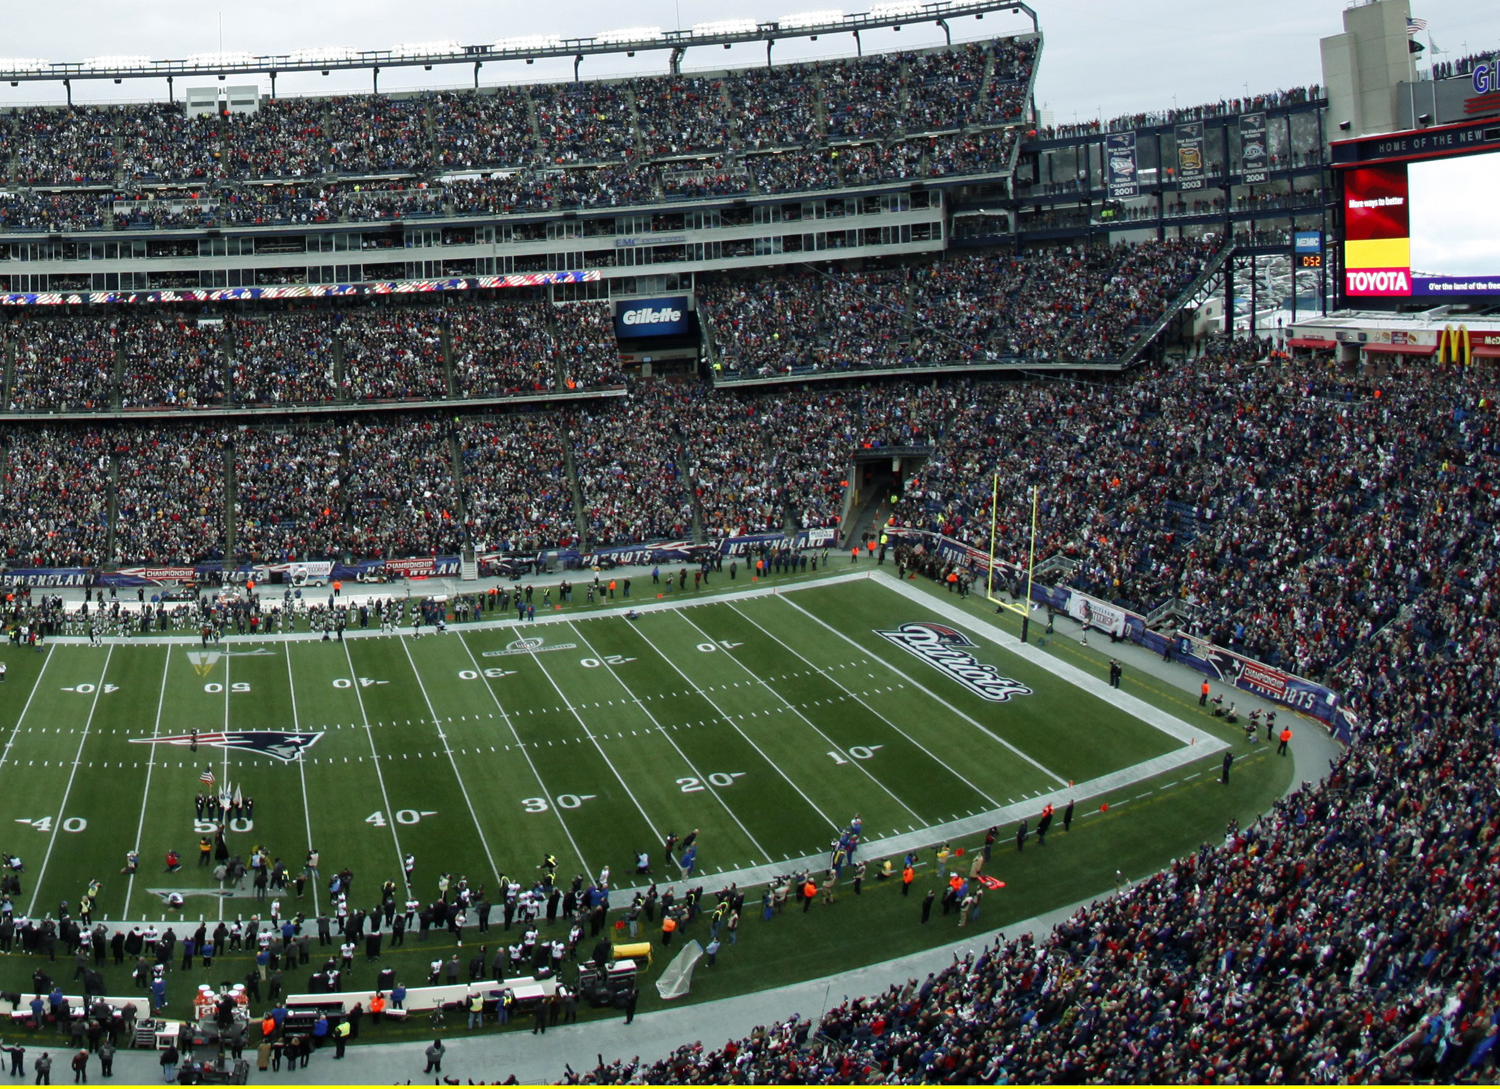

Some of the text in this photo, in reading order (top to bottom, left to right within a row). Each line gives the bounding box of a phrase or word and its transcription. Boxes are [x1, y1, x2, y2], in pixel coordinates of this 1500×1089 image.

[1379, 129, 1482, 153] HOME OF THE NEW
[1181, 180, 1202, 189] 2003
[1246, 173, 1266, 183] 2004
[1114, 187, 1134, 196] 2001
[1303, 256, 1321, 267] 0:52
[1346, 271, 1408, 291] TOYOTA
[623, 307, 682, 325] Gillette
[386, 561, 434, 570] CHAMPIONSHIP
[580, 654, 625, 668] 20
[880, 624, 1033, 701] Patriots
[458, 667, 506, 680] 30
[76, 683, 120, 694] 40
[204, 682, 251, 693] 50
[332, 677, 375, 688] 40
[826, 746, 874, 765] 10
[675, 772, 734, 793] 20
[521, 794, 582, 812] 30
[31, 816, 88, 832] 40
[193, 817, 254, 834] 50
[365, 810, 421, 827] 40
